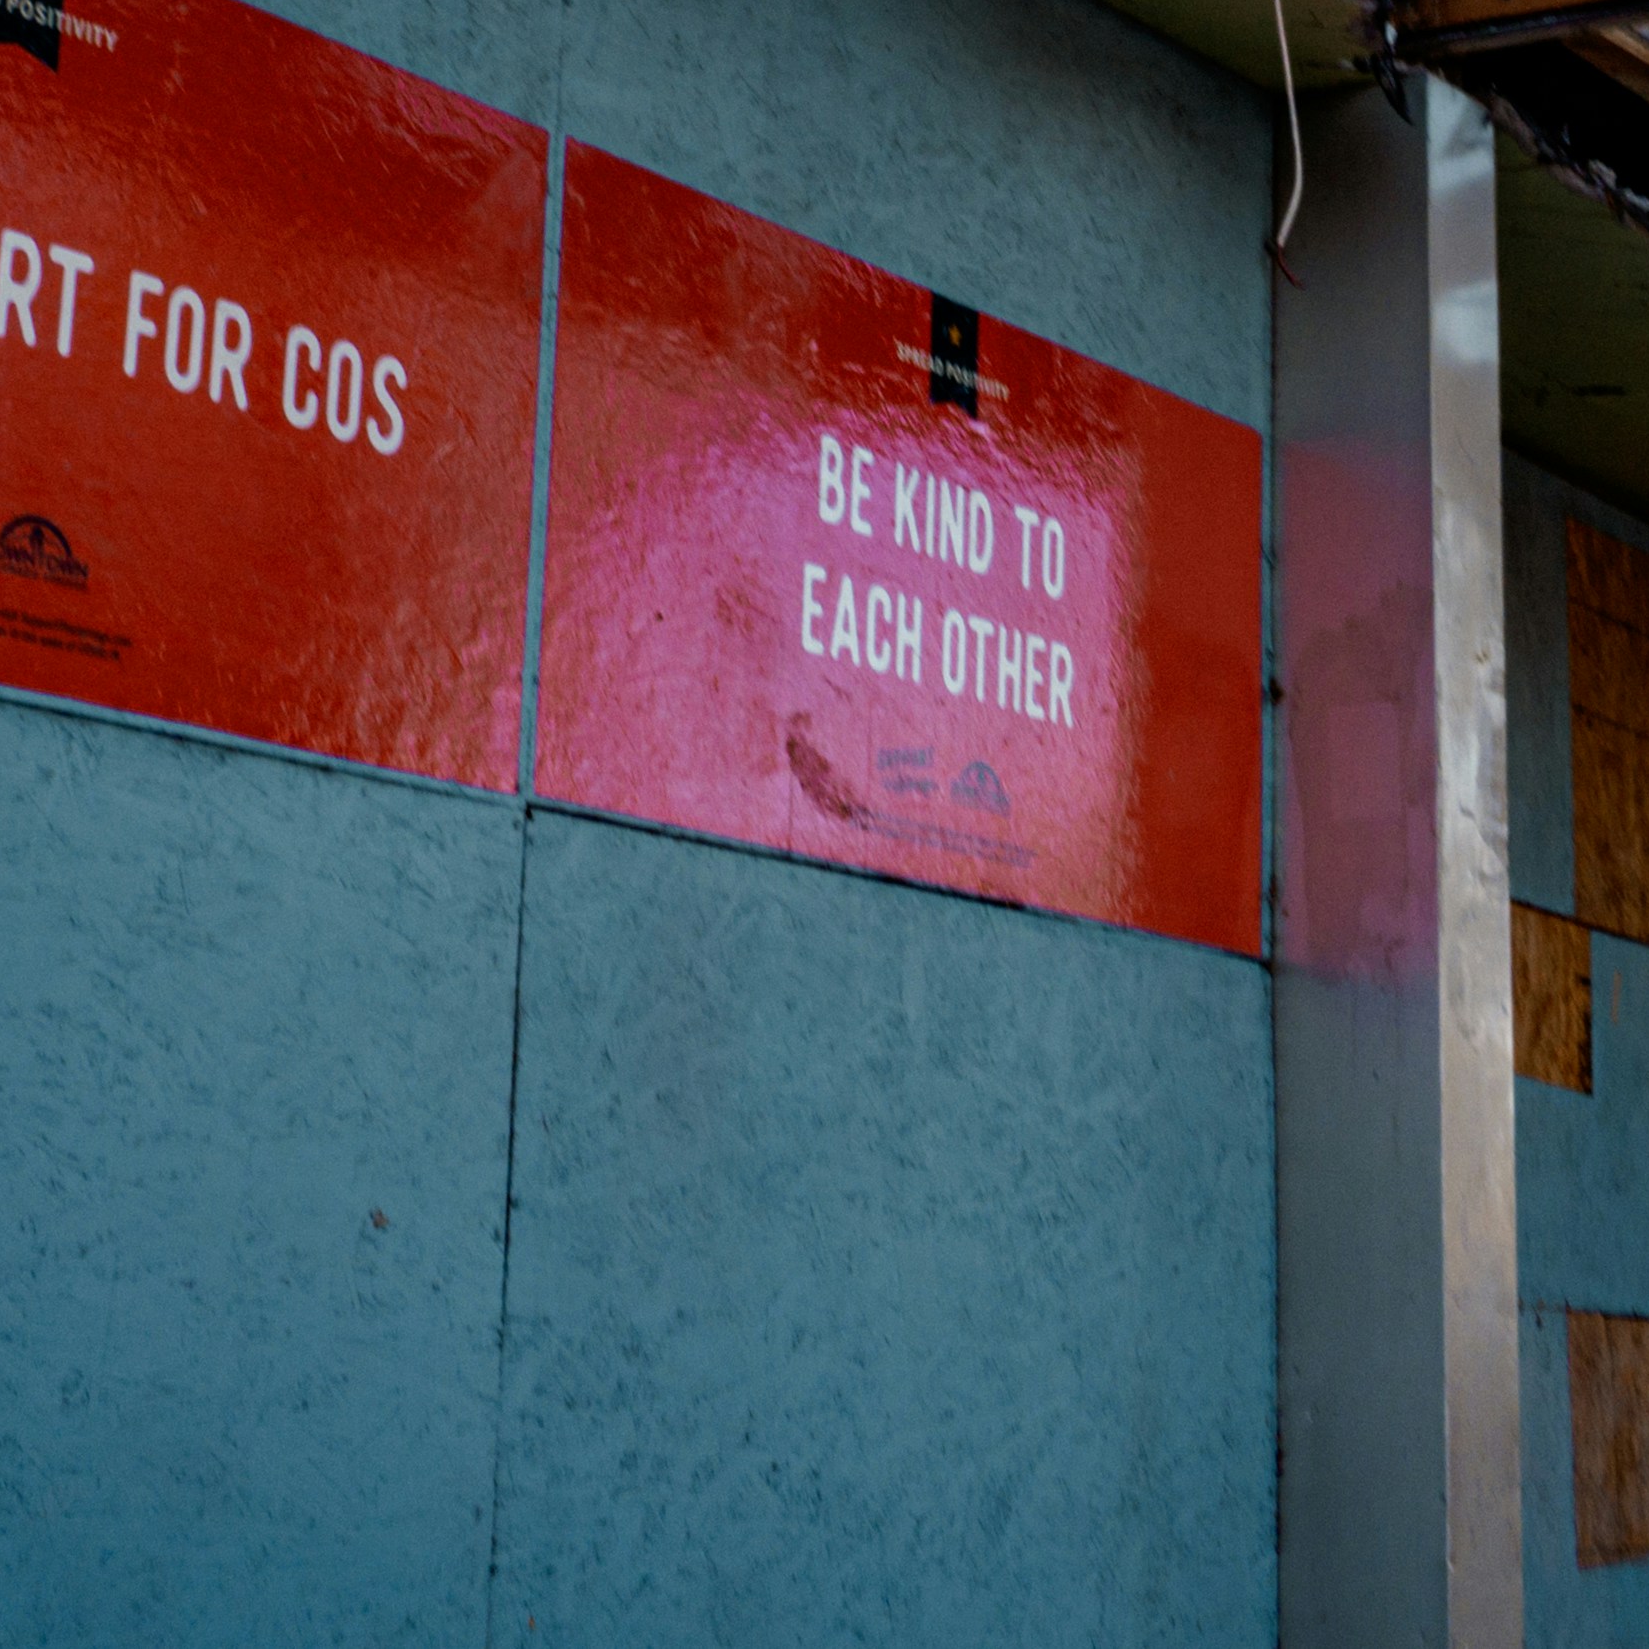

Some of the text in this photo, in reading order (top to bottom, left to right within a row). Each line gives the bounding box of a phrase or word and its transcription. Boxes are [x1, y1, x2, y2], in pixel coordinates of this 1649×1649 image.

[121, 269, 253, 412] FOR
[281, 324, 410, 457] COS
[818, 433, 1066, 601] BE KIND TO
[800, 561, 1076, 730] EACH OTHER
